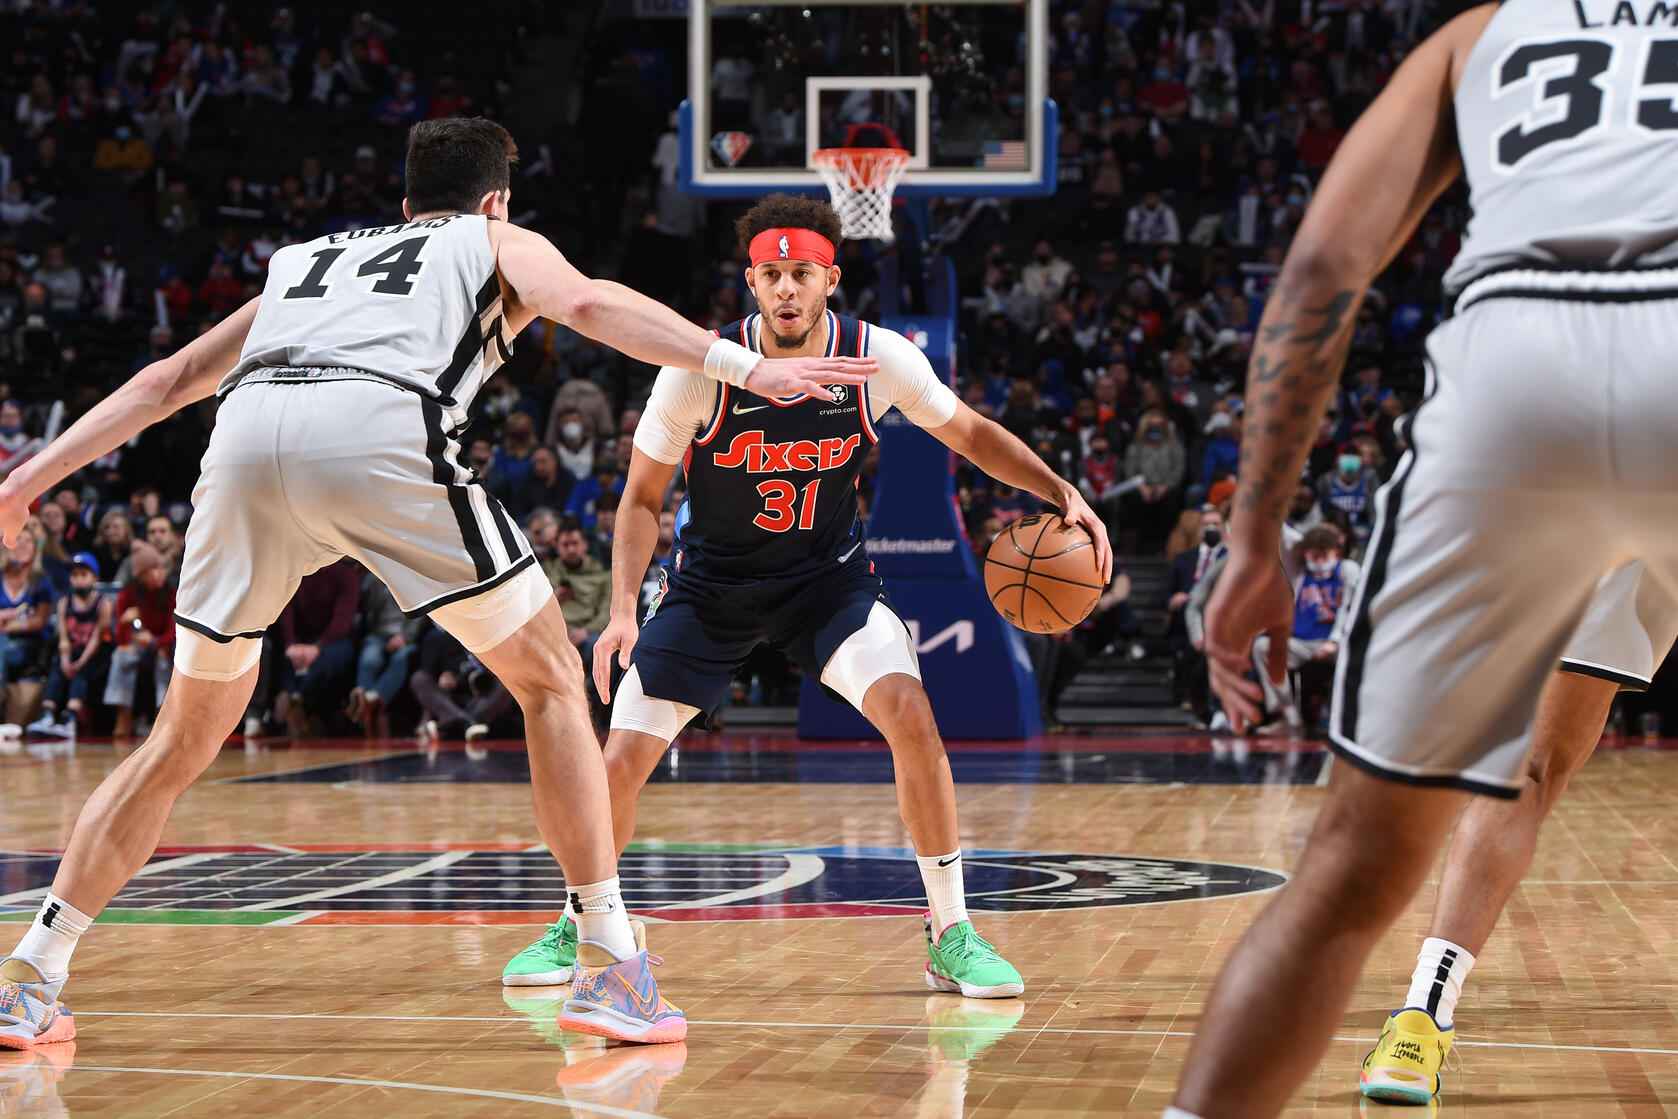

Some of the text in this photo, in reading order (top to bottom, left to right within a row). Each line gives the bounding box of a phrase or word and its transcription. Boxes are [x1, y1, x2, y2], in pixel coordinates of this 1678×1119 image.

[281, 233, 431, 301] 14
[819, 406, 858, 416] crypto.com
[714, 430, 861, 473] Sixers
[752, 478, 821, 532] 31
